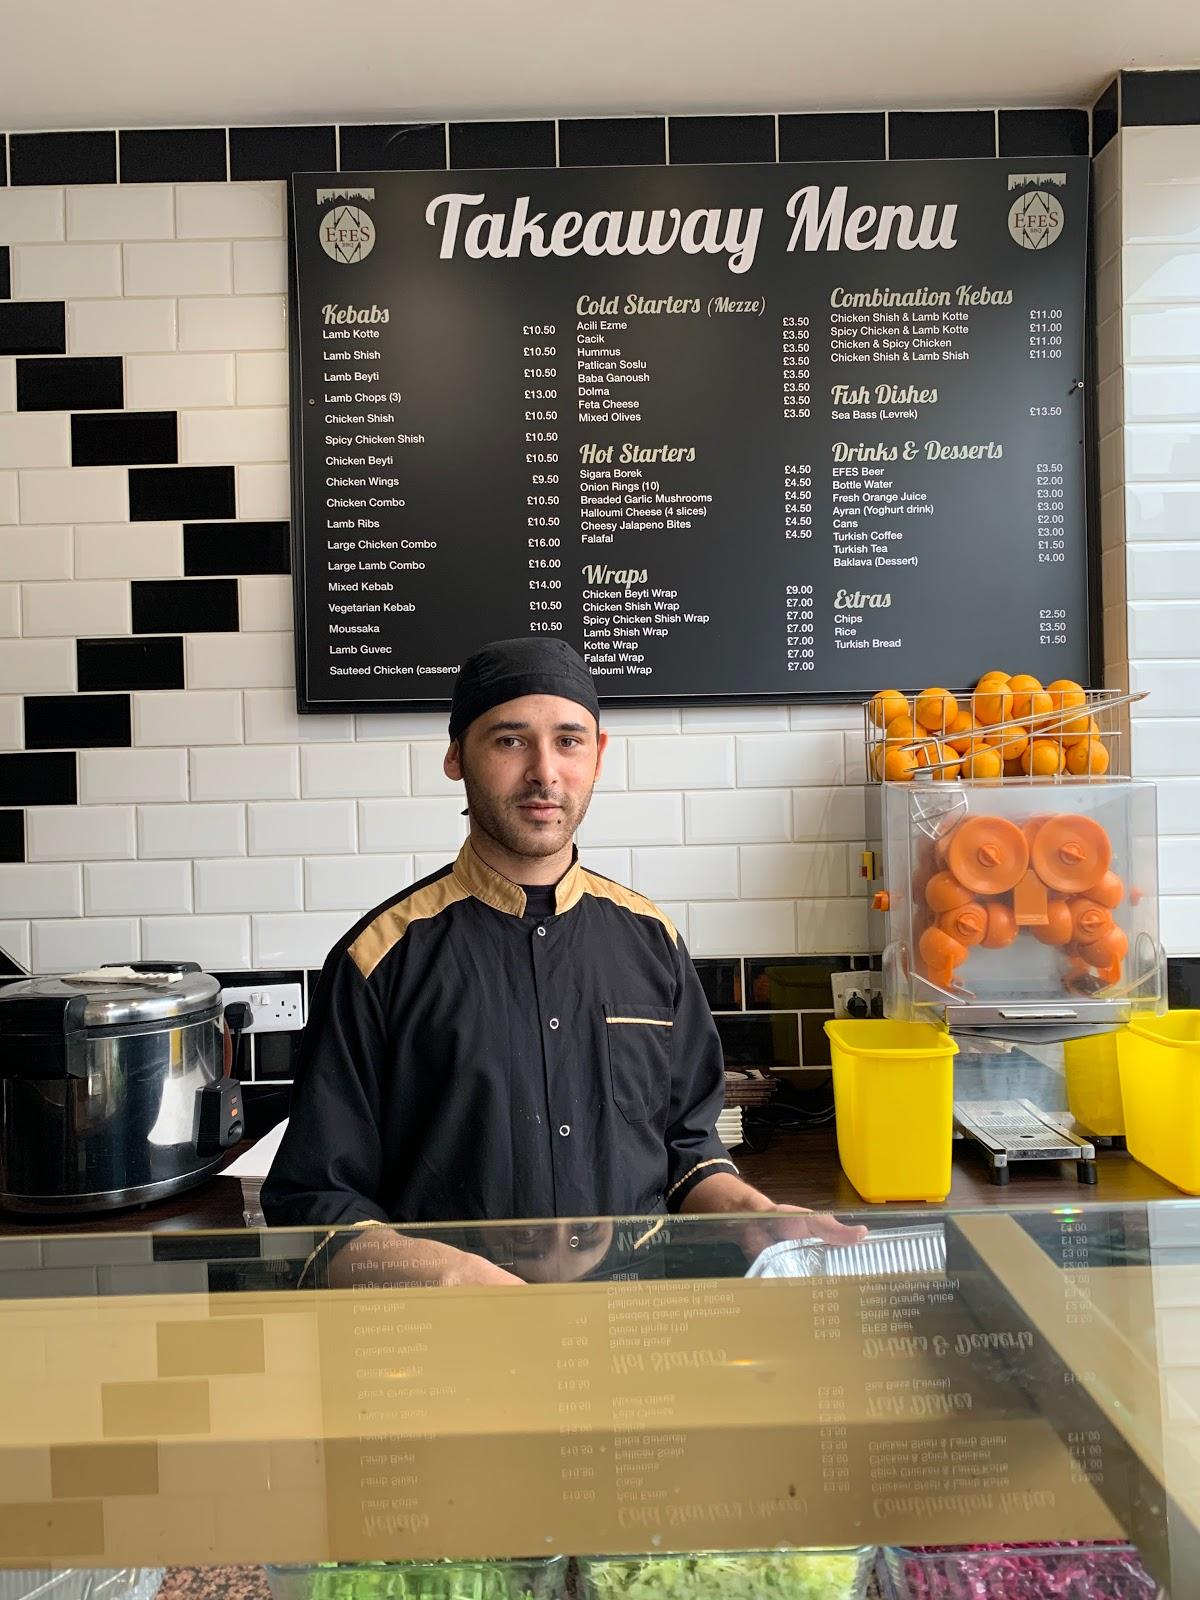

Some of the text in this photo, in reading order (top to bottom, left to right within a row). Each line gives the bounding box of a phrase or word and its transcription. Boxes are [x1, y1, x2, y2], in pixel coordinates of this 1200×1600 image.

[1014, 211, 1059, 228] EFES
[326, 226, 370, 243] EFES
[424, 185, 958, 274] Takeaway Menu
[830, 285, 1013, 308] Combination Kebas
[576, 294, 765, 317] Cold Starters (Mezze)
[321, 304, 389, 324] Kebabs
[830, 312, 968, 323] Chicken Shish & Lamb Kotte
[1030, 309, 1062, 319] £11.00
[523, 325, 555, 335] £10.50
[577, 321, 627, 330] Acili Ezme
[323, 329, 379, 339] Lamb Kotte
[783, 330, 809, 339] £3.50
[831, 338, 952, 350] Chicken & Spicy Chicken
[1030, 336, 1062, 345] £11.00
[577, 348, 621, 357] Hummus
[831, 351, 969, 362] Chicken Shish & Lamb Shish
[578, 360, 647, 370] Patlican Soslu
[783, 356, 810, 366] £3.50
[324, 372, 379, 383] Lamb Beyti
[524, 368, 556, 378] £10.50
[578, 387, 610, 396] Dolma
[783, 383, 810, 392] £3.50
[325, 392, 401, 403] Lamb Chops (3)
[831, 384, 937, 405] Fish Dishes
[525, 411, 557, 420] £10.50
[784, 409, 810, 418] £3.50
[831, 409, 917, 420] Sea Bass (Levrek)
[1030, 407, 1062, 416] £13.50
[325, 414, 394, 423] Chicken Shish
[579, 412, 641, 422] Mixed Olives
[325, 434, 425, 446] Spicy Chicken Shish
[579, 443, 695, 464] Hot Starters
[832, 440, 1002, 462] Drinks & Desserts
[526, 453, 558, 463] £10.50
[580, 469, 642, 480] Sigara Borek
[832, 467, 884, 477] EFES Beer
[326, 477, 399, 488] Chicken Wings
[785, 478, 811, 487] £4.50
[833, 480, 893, 489] Bottle Water
[1037, 476, 1063, 485] £2.00
[580, 481, 659, 493] Onion Rings (10)
[527, 496, 559, 505] £10.50
[833, 492, 927, 503] Fresh Orange Juice
[581, 506, 707, 517] Halloumi Cheese (4 slices)
[785, 504, 812, 513] £4.50
[832, 504, 934, 517] Ayran (Yoghurt drink)
[1037, 502, 1064, 511] £3.00
[327, 519, 380, 528] Lamb Ribs
[581, 520, 691, 532] Cheesy Jalapeno Bites
[833, 519, 858, 528] Cans
[785, 529, 812, 539] £4.50
[833, 531, 903, 541] Turkish Coffee
[1038, 527, 1064, 536] £3.00
[528, 538, 560, 547] £16.00
[581, 534, 613, 543] Falafal
[327, 539, 437, 551] Large Chicken Combo
[834, 556, 918, 567] Baklava (Dessert)
[1038, 553, 1065, 562] £4.00
[582, 565, 648, 589] Wraps
[328, 582, 394, 591] Mixed Kebab
[529, 580, 561, 589] £14.00
[582, 589, 677, 600] Chicken Beyti Wrap
[834, 589, 891, 609] Extras
[786, 598, 813, 607] £7.00
[328, 603, 416, 614] Vegetarian Kebab
[583, 614, 709, 626] Spicy Chicken Shish Wrap
[834, 614, 863, 625] Chips
[329, 624, 380, 633] Moussaka
[530, 622, 562, 631] £10.50
[787, 623, 813, 633] £7.00
[835, 627, 856, 636] Rice
[1040, 622, 1066, 631] £3.50
[834, 639, 901, 649] Turkish Bread
[584, 653, 644, 663] Falafal Wrap
[787, 649, 814, 658] £7.00
[330, 665, 460, 675] Sauteed Chicken (casserol
[626, 665, 652, 676] Wrap
